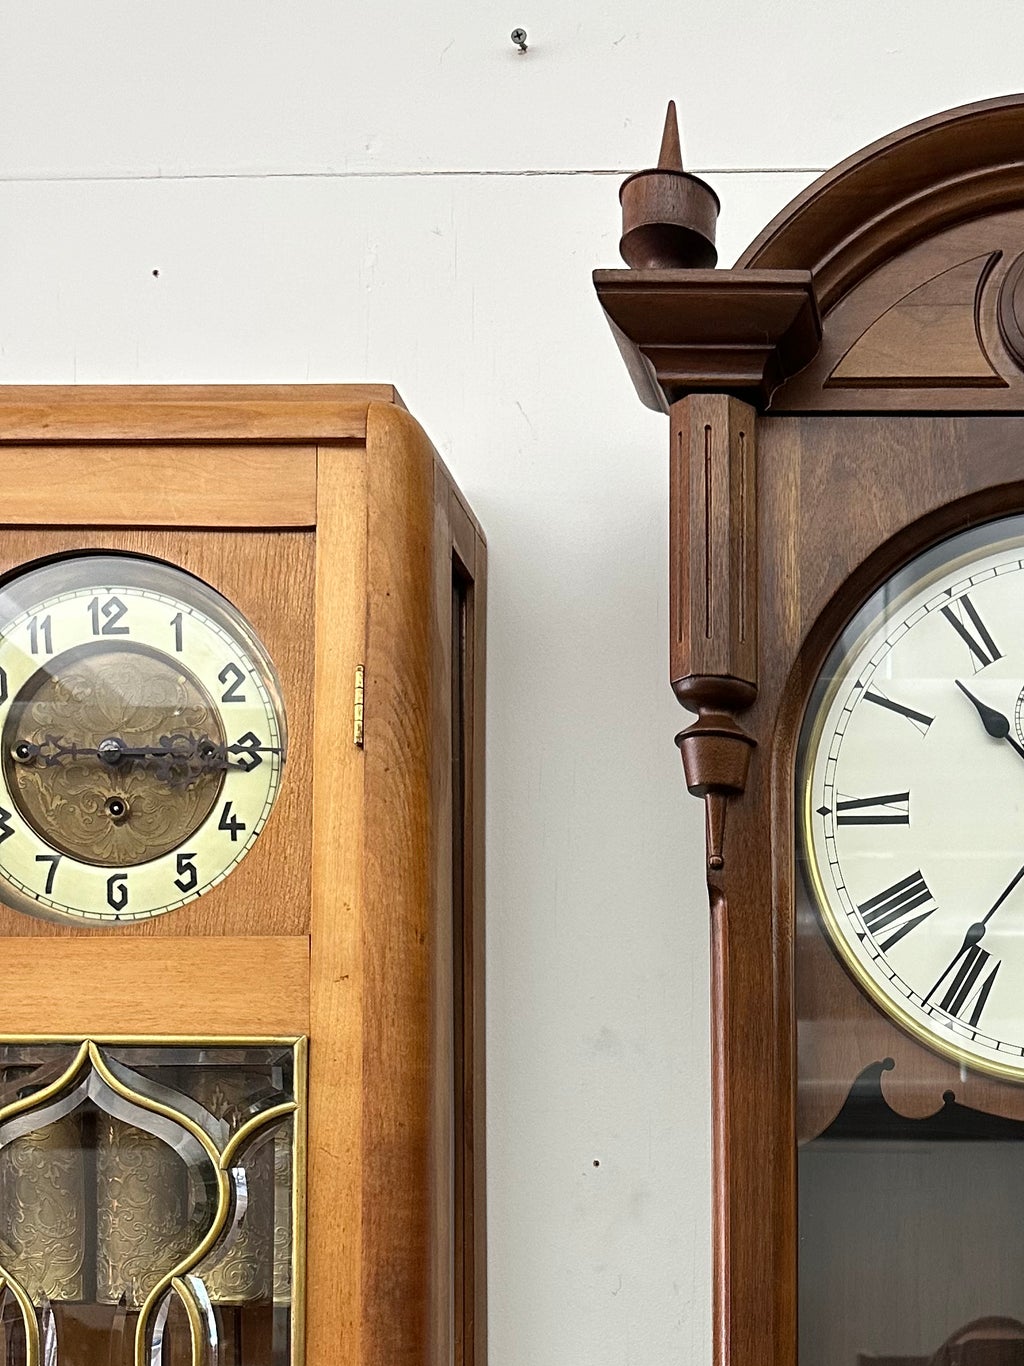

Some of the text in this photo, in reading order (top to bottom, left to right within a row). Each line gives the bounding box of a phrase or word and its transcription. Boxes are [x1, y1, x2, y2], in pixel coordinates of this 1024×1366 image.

[27, 614, 54, 655] 11
[87, 596, 130, 635] 12
[170, 612, 183, 652] 1
[940, 594, 1006, 673] XI
[218, 662, 247, 703] 2
[861, 684, 937, 737] X
[232, 731, 262, 772] 3
[218, 801, 246, 842] 4
[836, 790, 910, 826] IX
[35, 854, 63, 894] 7
[107, 873, 128, 911] 6
[174, 852, 198, 893] 5
[856, 868, 938, 956] VIII
